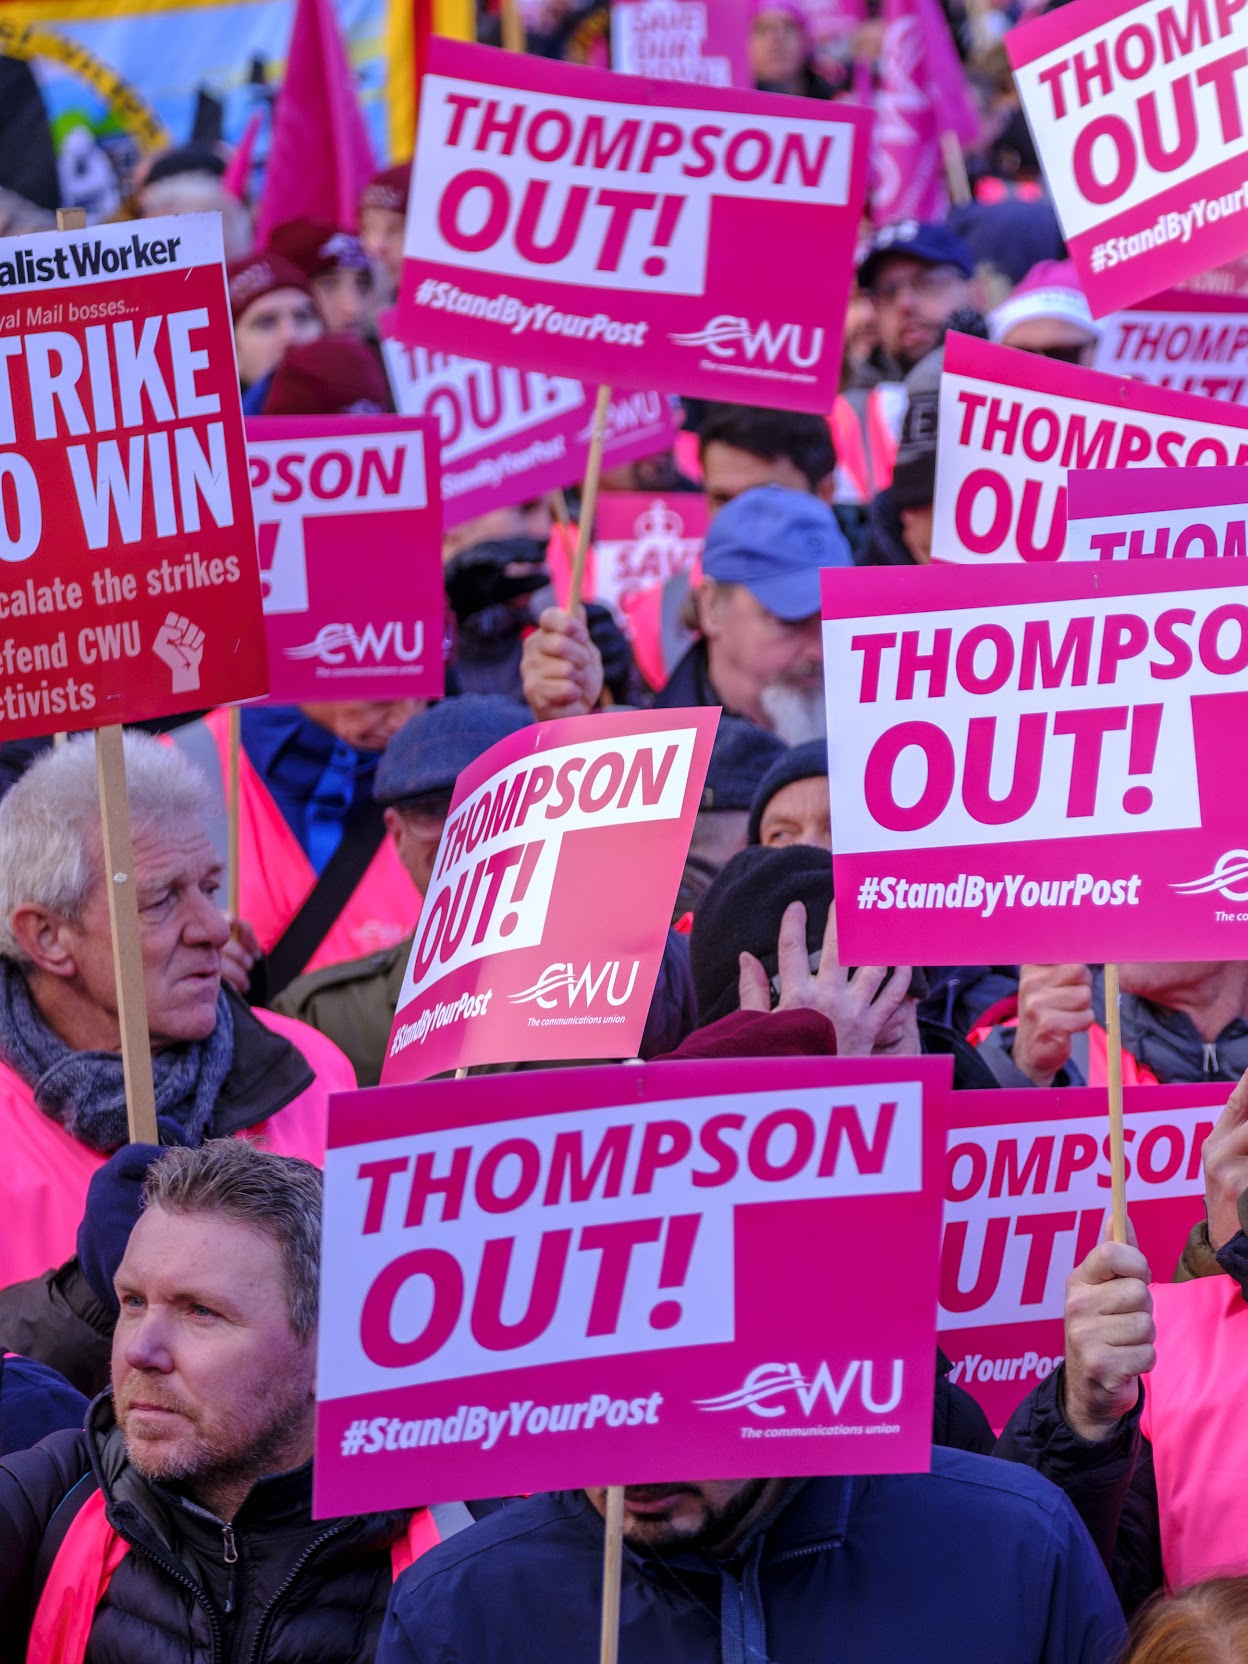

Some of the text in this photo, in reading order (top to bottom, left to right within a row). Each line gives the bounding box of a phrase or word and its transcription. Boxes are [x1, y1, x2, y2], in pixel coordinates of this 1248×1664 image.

[444, 93, 834, 188] THOMPSON
[437, 168, 687, 278] OUT!
[69, 234, 181, 278] Worker
[26, 304, 63, 327] Mail
[69, 299, 140, 322] bosses...
[415, 278, 648, 346] #StandByYourPost
[704, 314, 824, 368] CWU
[0, 307, 222, 445] TRIKE
[66, 421, 235, 550] WIN
[92, 567, 138, 606] the
[146, 552, 241, 597] strikes
[78, 620, 141, 666] CWU
[315, 619, 424, 665] CWU
[864, 702, 1164, 832] OUT!
[436, 744, 679, 882] THOMPSON
[413, 839, 546, 986] OUT!
[858, 873, 1142, 918] #StandByYourPost
[1215, 910, 1235, 922] The
[536, 960, 640, 1009] CWU
[527, 1014, 626, 1027] The communications union
[357, 1101, 899, 1236] THOMPSON
[360, 1212, 703, 1369] OUT!
[743, 1358, 904, 1418] CWU
[341, 1392, 663, 1456] #StandByYourPost
[740, 1422, 901, 1439] The communications union
